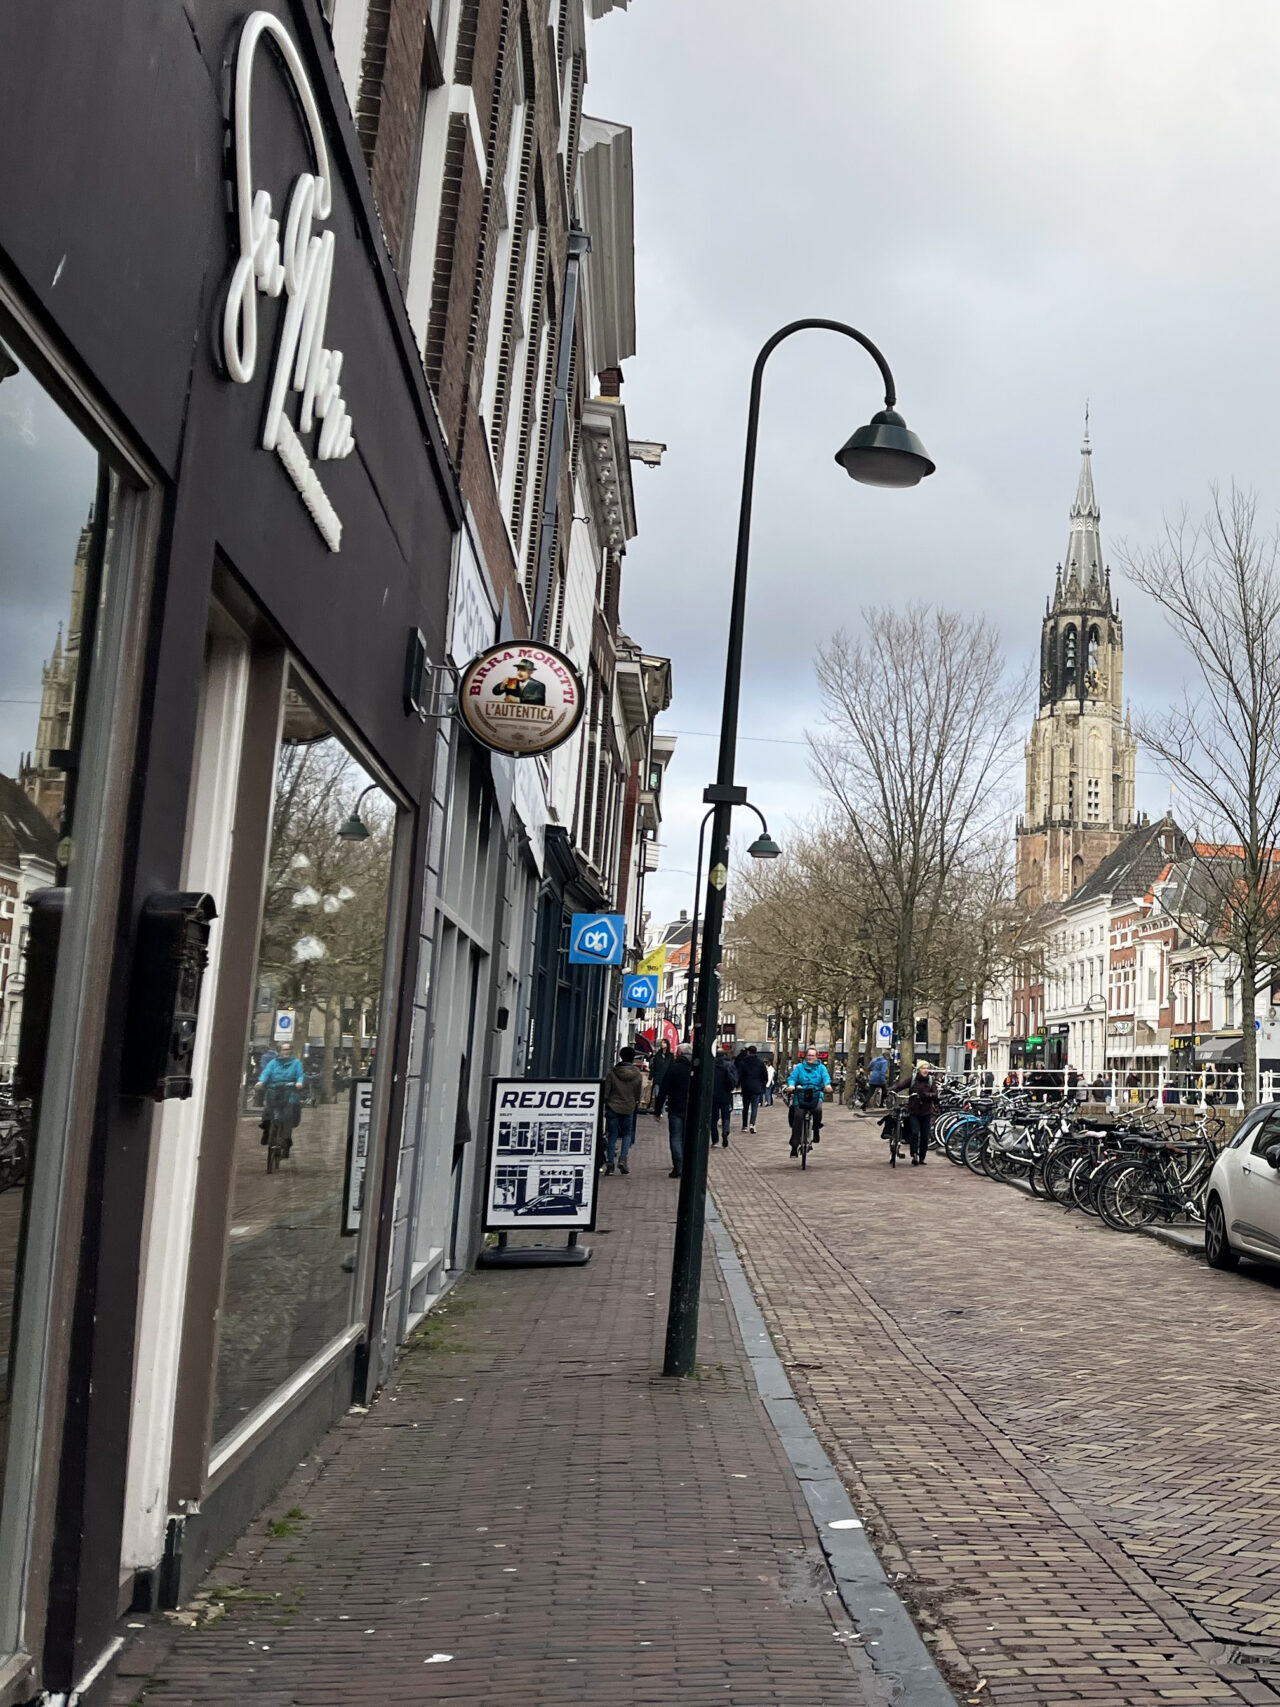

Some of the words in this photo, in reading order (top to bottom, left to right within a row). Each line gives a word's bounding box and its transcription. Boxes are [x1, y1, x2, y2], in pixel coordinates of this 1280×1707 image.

[469, 651, 514, 696] BIRRA
[518, 649, 574, 705] MORETTI
[485, 704, 554, 721] L'AUTENTICA
[500, 1091, 596, 1109] REJOES
